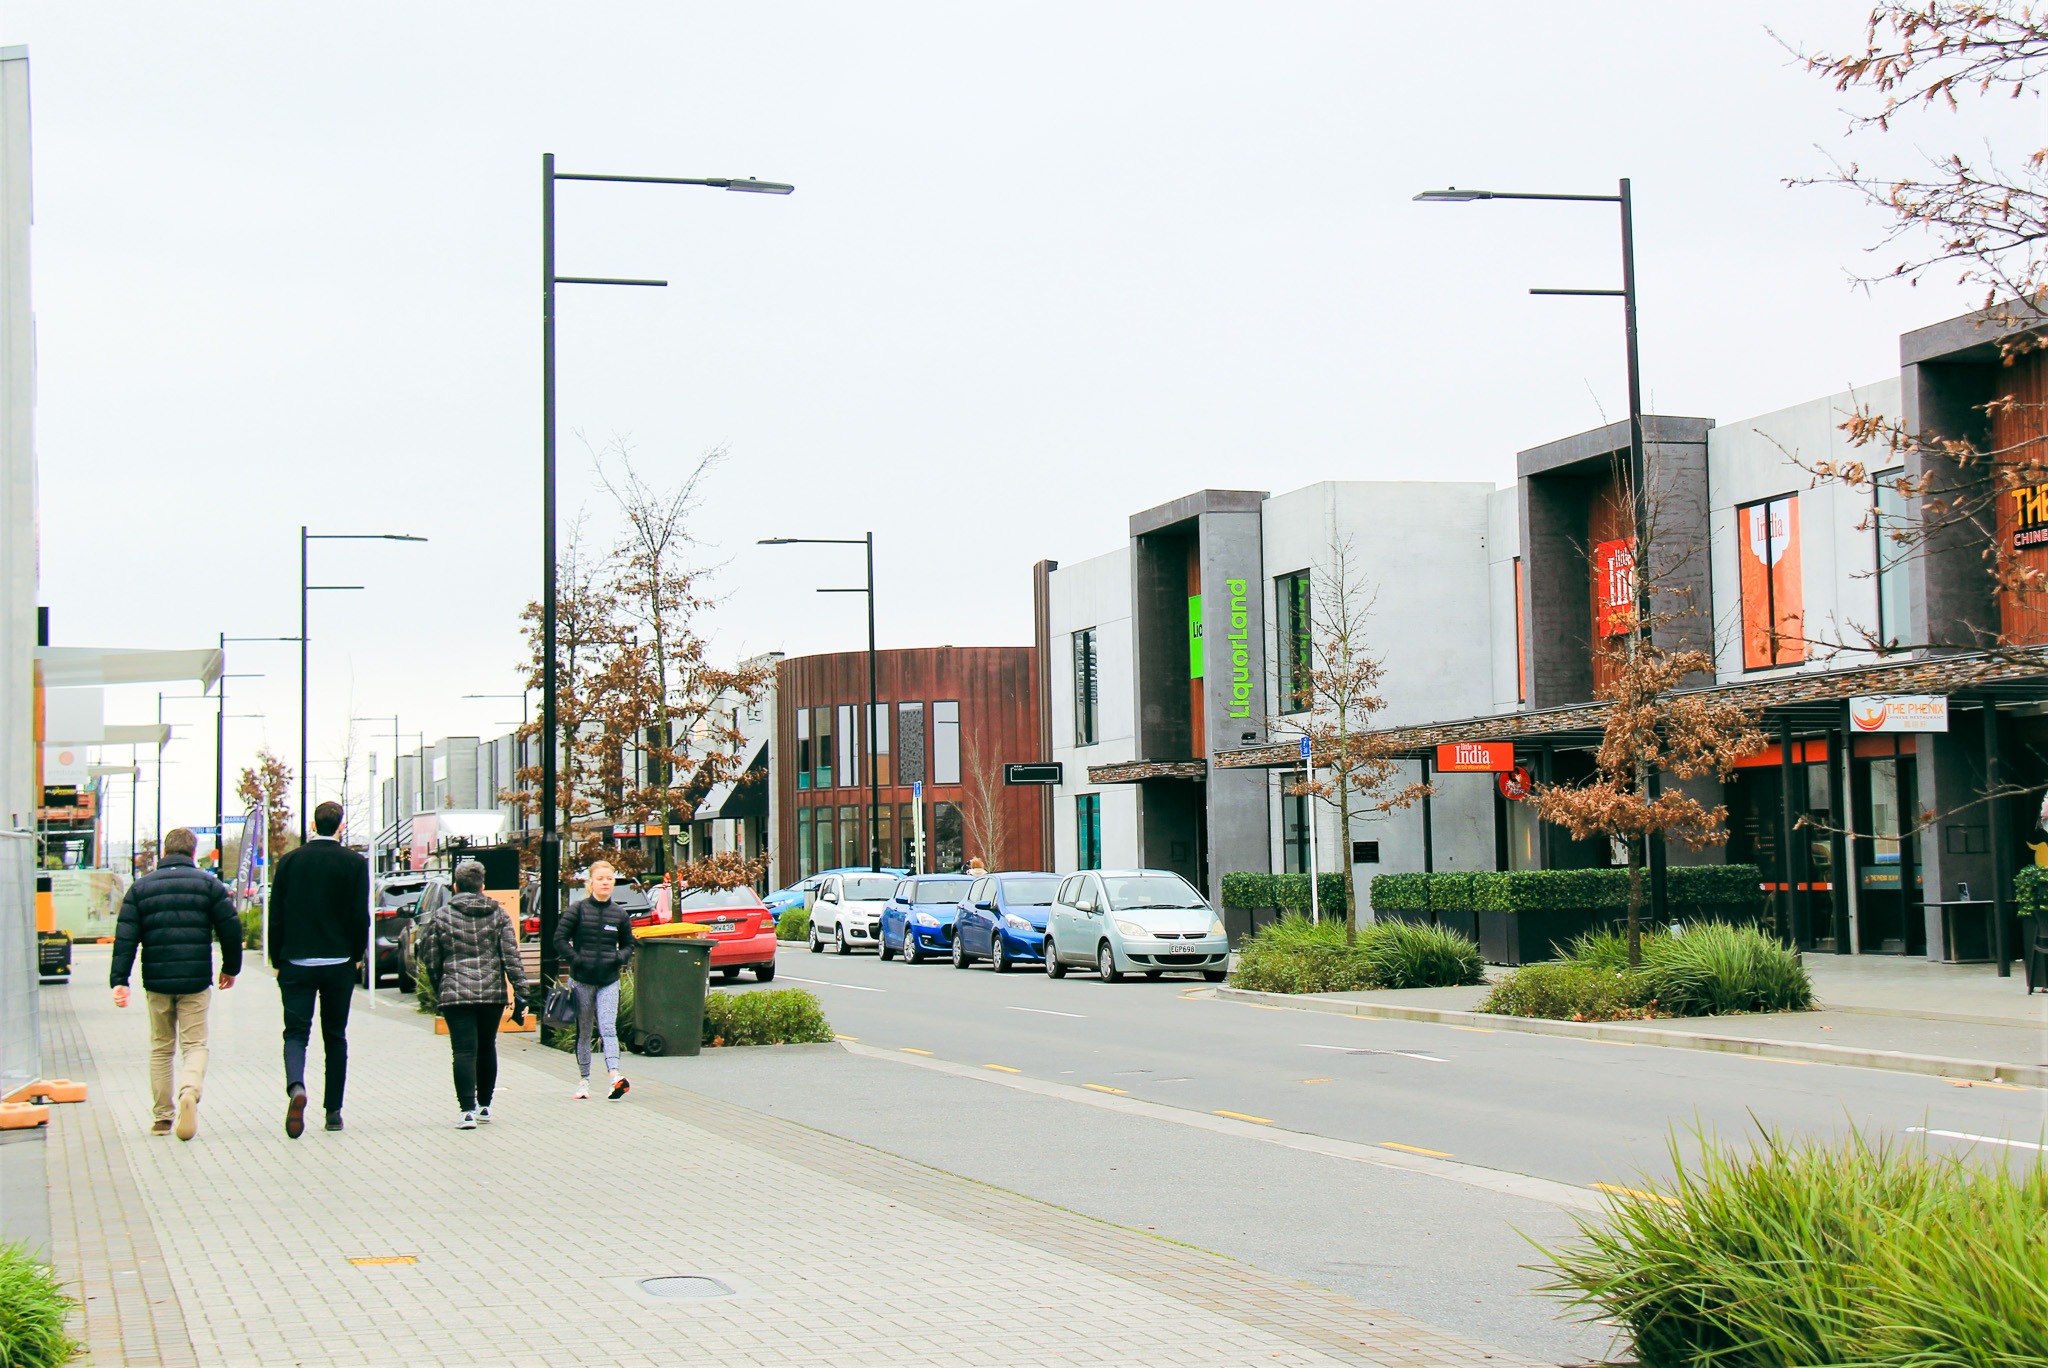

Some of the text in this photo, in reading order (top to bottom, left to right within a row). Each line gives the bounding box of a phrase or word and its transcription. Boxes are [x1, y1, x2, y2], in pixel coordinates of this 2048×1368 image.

[2011, 483, 2048, 526] THE
[1226, 579, 1254, 718] LiquorLand
[1886, 703, 1944, 715] THE PHENIX
[1455, 744, 1490, 764] India
